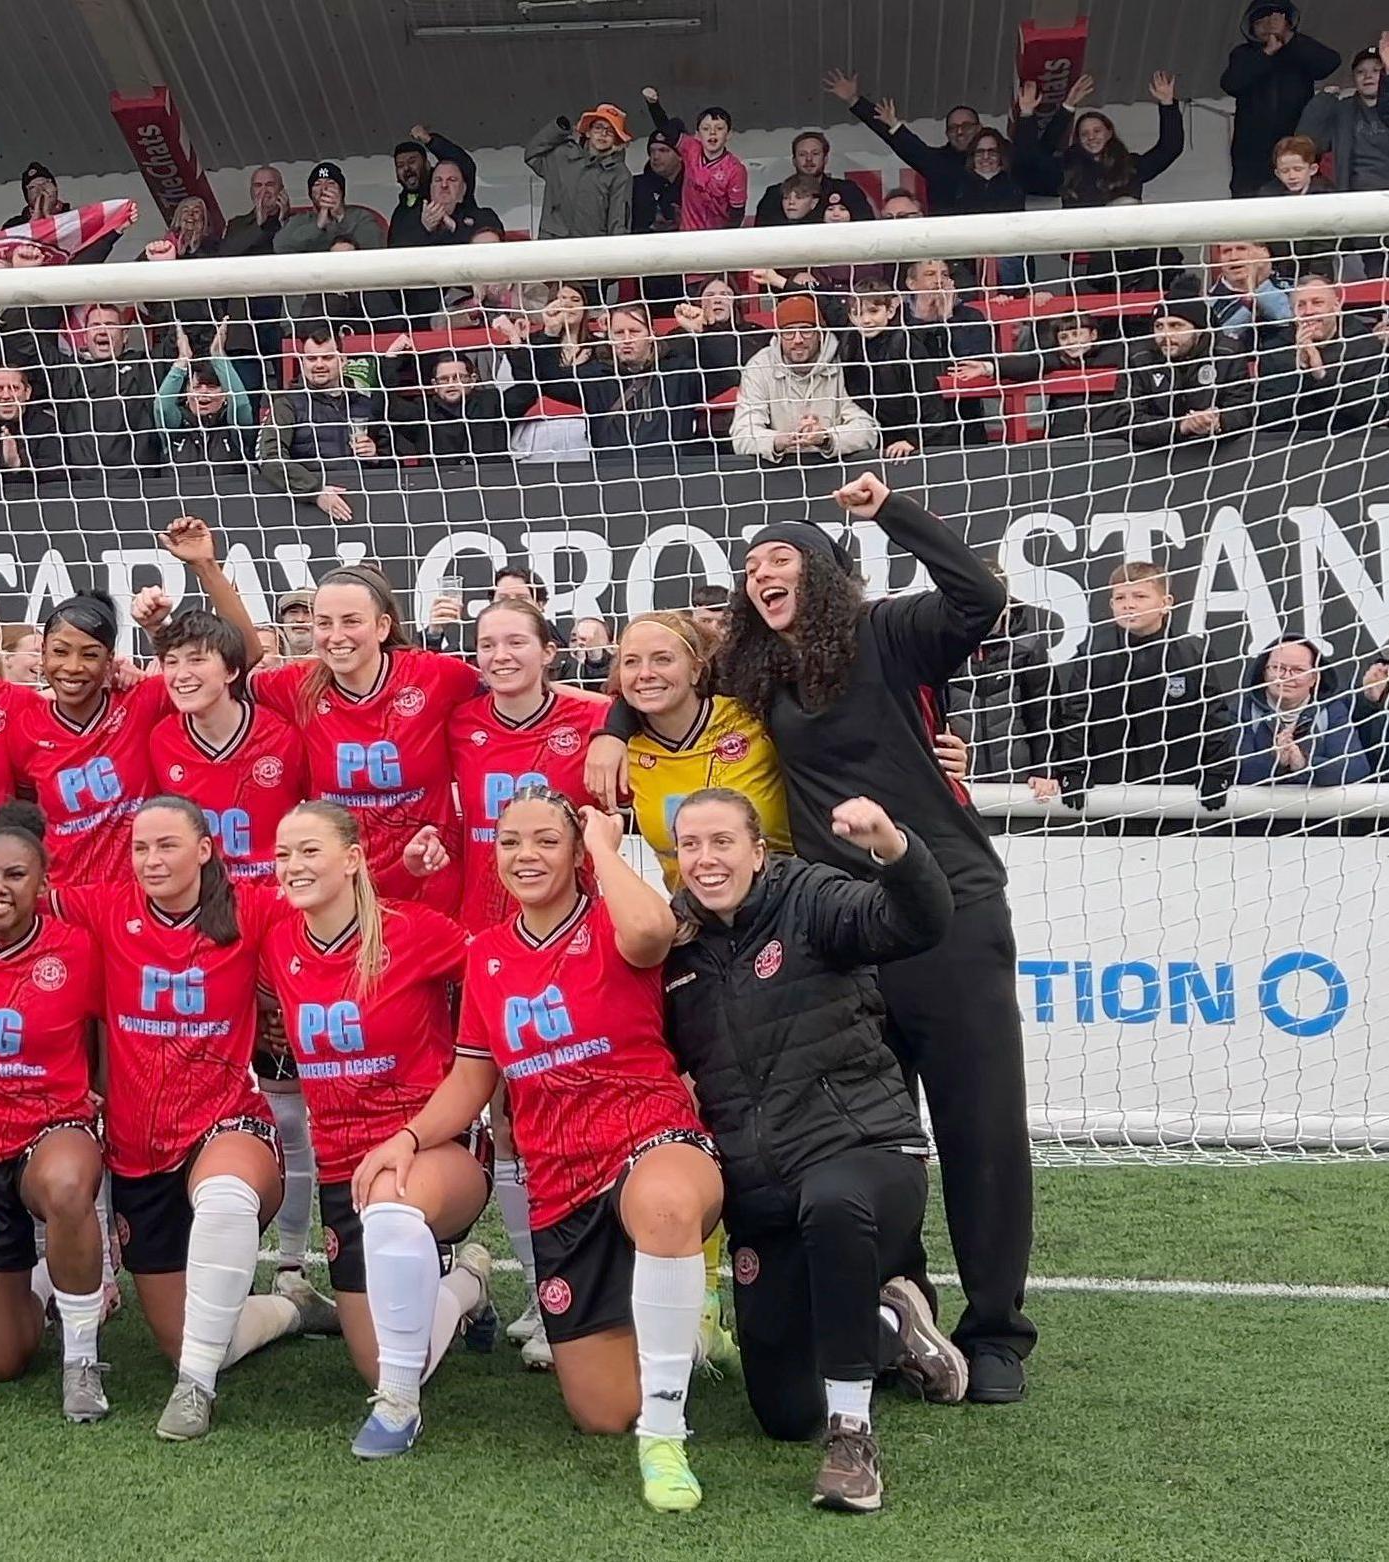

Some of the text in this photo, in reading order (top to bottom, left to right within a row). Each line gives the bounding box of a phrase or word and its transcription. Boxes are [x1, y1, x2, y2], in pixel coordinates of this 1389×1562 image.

[56, 755, 122, 813] PG
[337, 740, 403, 789] PG
[141, 965, 206, 1016] PG
[1017, 960, 1236, 1025] TION
[118, 1014, 232, 1039] POWERED ACCESS
[298, 1000, 365, 1055] PG
[503, 984, 574, 1053] PG
[345, 1054, 396, 1077] ACCESS
[555, 1036, 611, 1066] ACCESS
